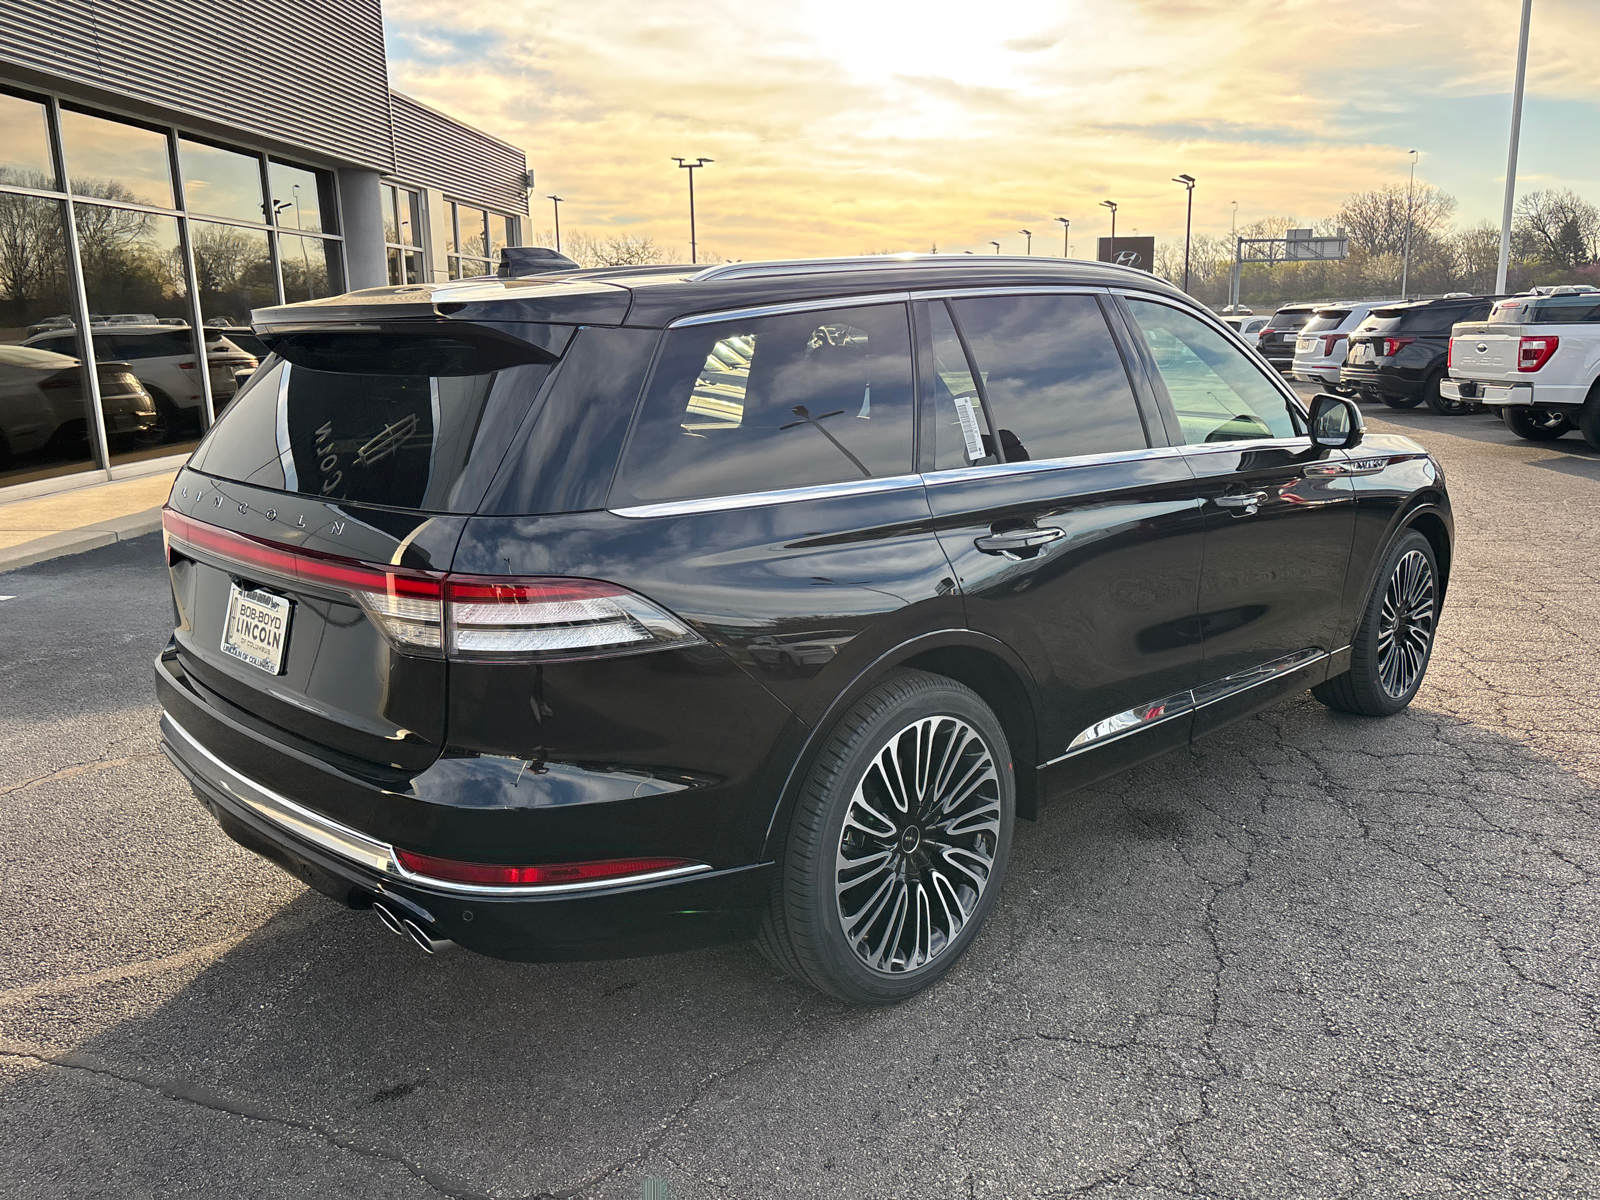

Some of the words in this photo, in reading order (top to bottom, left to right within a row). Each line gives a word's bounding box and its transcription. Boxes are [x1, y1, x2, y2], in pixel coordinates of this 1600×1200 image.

[181, 486, 346, 536] LINCOLN
[240, 604, 282, 630] BOB-BOYD
[236, 618, 281, 650] LINCOLN
